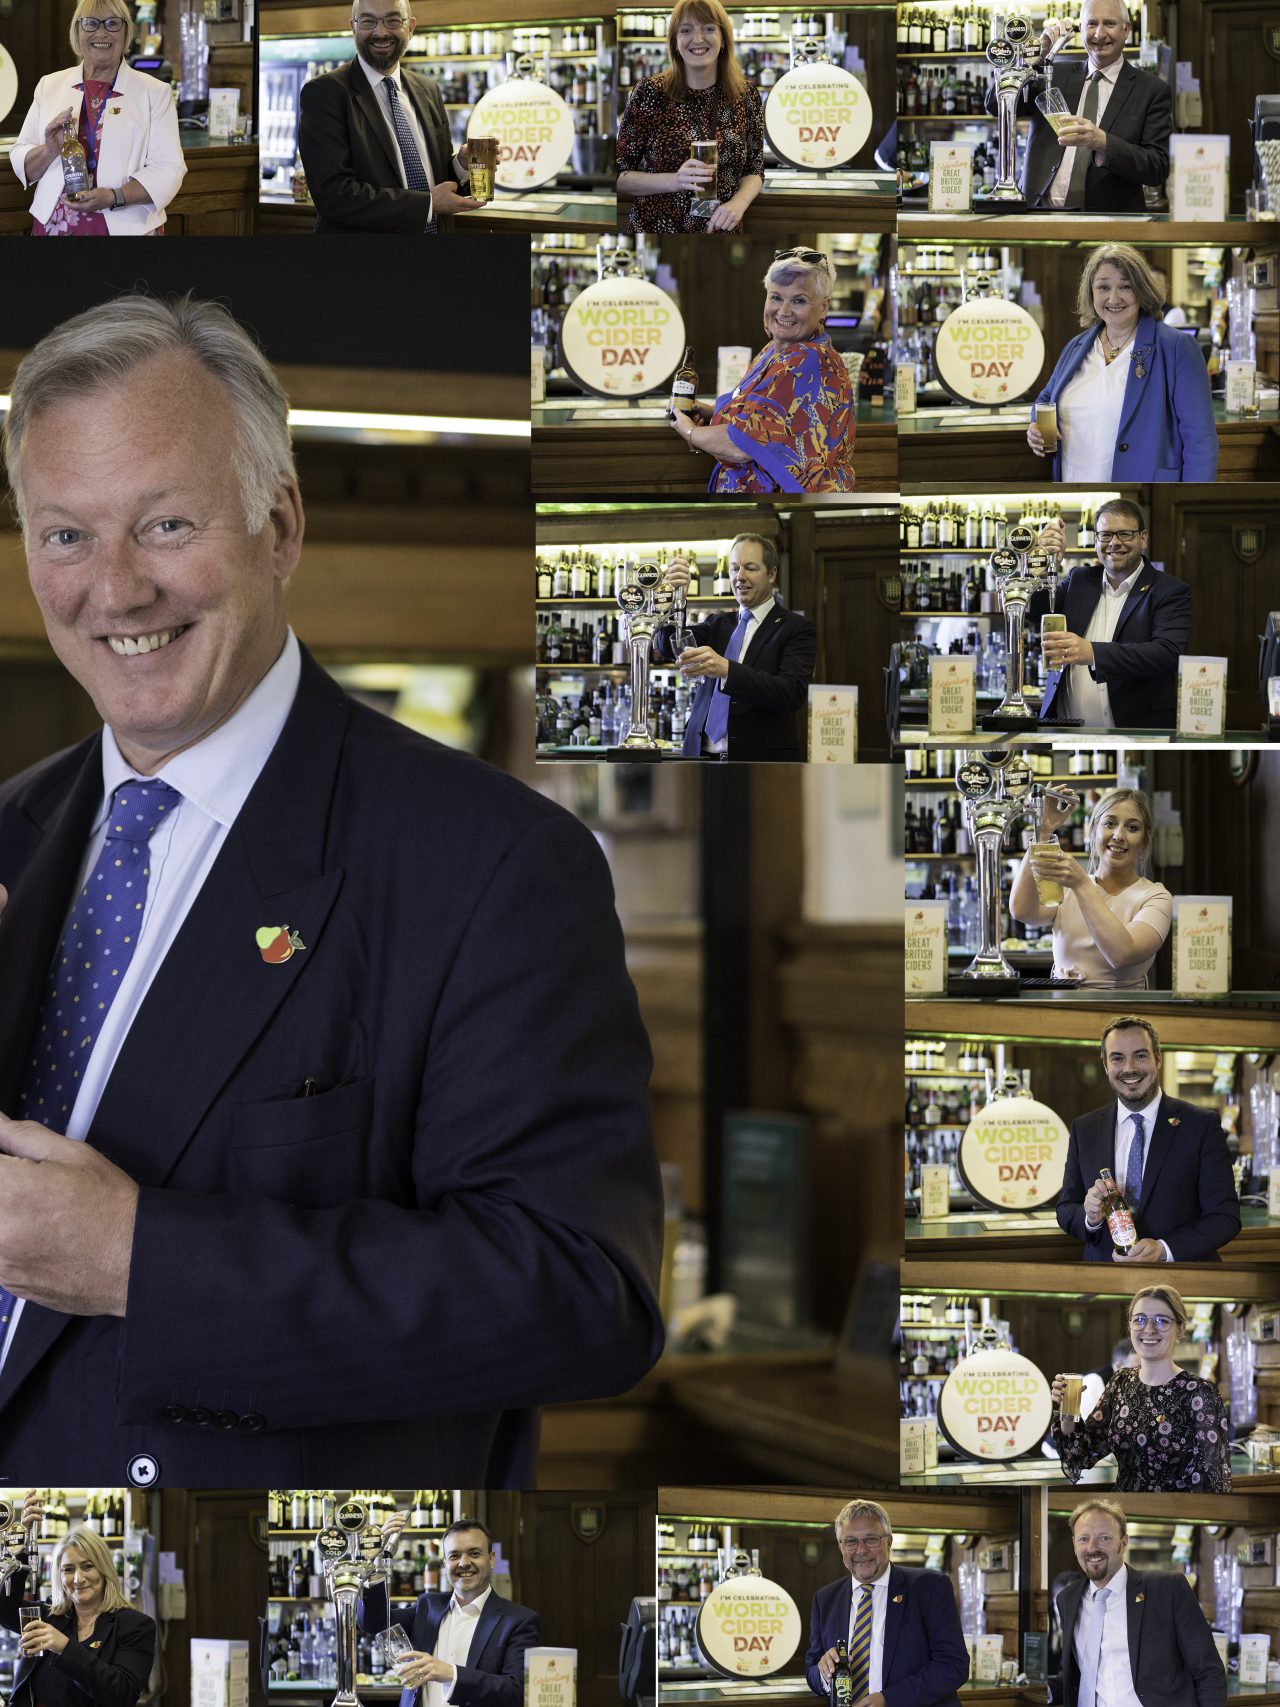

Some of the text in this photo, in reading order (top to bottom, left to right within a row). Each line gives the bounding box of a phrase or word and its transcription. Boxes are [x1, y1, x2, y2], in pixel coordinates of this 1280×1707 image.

[777, 91, 858, 107] WORLD
[479, 108, 560, 126] WORLD
[786, 108, 851, 125] CIDER
[799, 126, 841, 142] DAY
[499, 146, 541, 161] DAY
[942, 186, 960, 194] CIDERS
[577, 309, 670, 327] WORLD
[586, 328, 662, 346] CIDER
[949, 326, 1031, 343] WORLD
[602, 347, 650, 366] DAY
[957, 344, 1024, 360] CIDER
[970, 362, 1013, 378] DAY
[943, 687, 961, 695] GREAT
[1192, 688, 1211, 696] GREAT
[940, 696, 963, 704] BRITISH
[1190, 697, 1213, 706] BRITISH
[941, 705, 962, 714] CIDERS
[1190, 707, 1212, 716] CIDERS
[823, 718, 842, 726] GREAT
[821, 727, 845, 736] BRITISH
[821, 737, 843, 746] CIDERS
[961, 772, 990, 783] Carlsberg
[907, 938, 930, 947] GREAT
[1191, 936, 1214, 945] GREAT
[905, 950, 933, 959] BRITISH
[1188, 947, 1217, 957] BRITISH
[905, 960, 931, 970] CIDERS
[1189, 959, 1216, 970] CIDERS
[975, 1127, 1059, 1145] WORLD
[984, 1145, 1053, 1163] CIDER
[999, 1164, 1042, 1182] DAY
[955, 1379, 1038, 1396] WORLD
[963, 1397, 1032, 1414] CIDER
[977, 1416, 1021, 1432] DAY
[713, 1603, 789, 1618] WORLD
[721, 1620, 782, 1634] CIDER
[734, 1636, 773, 1652] DAY
[541, 1684, 561, 1692] GREAT
[538, 1694, 563, 1703] BRITISH
